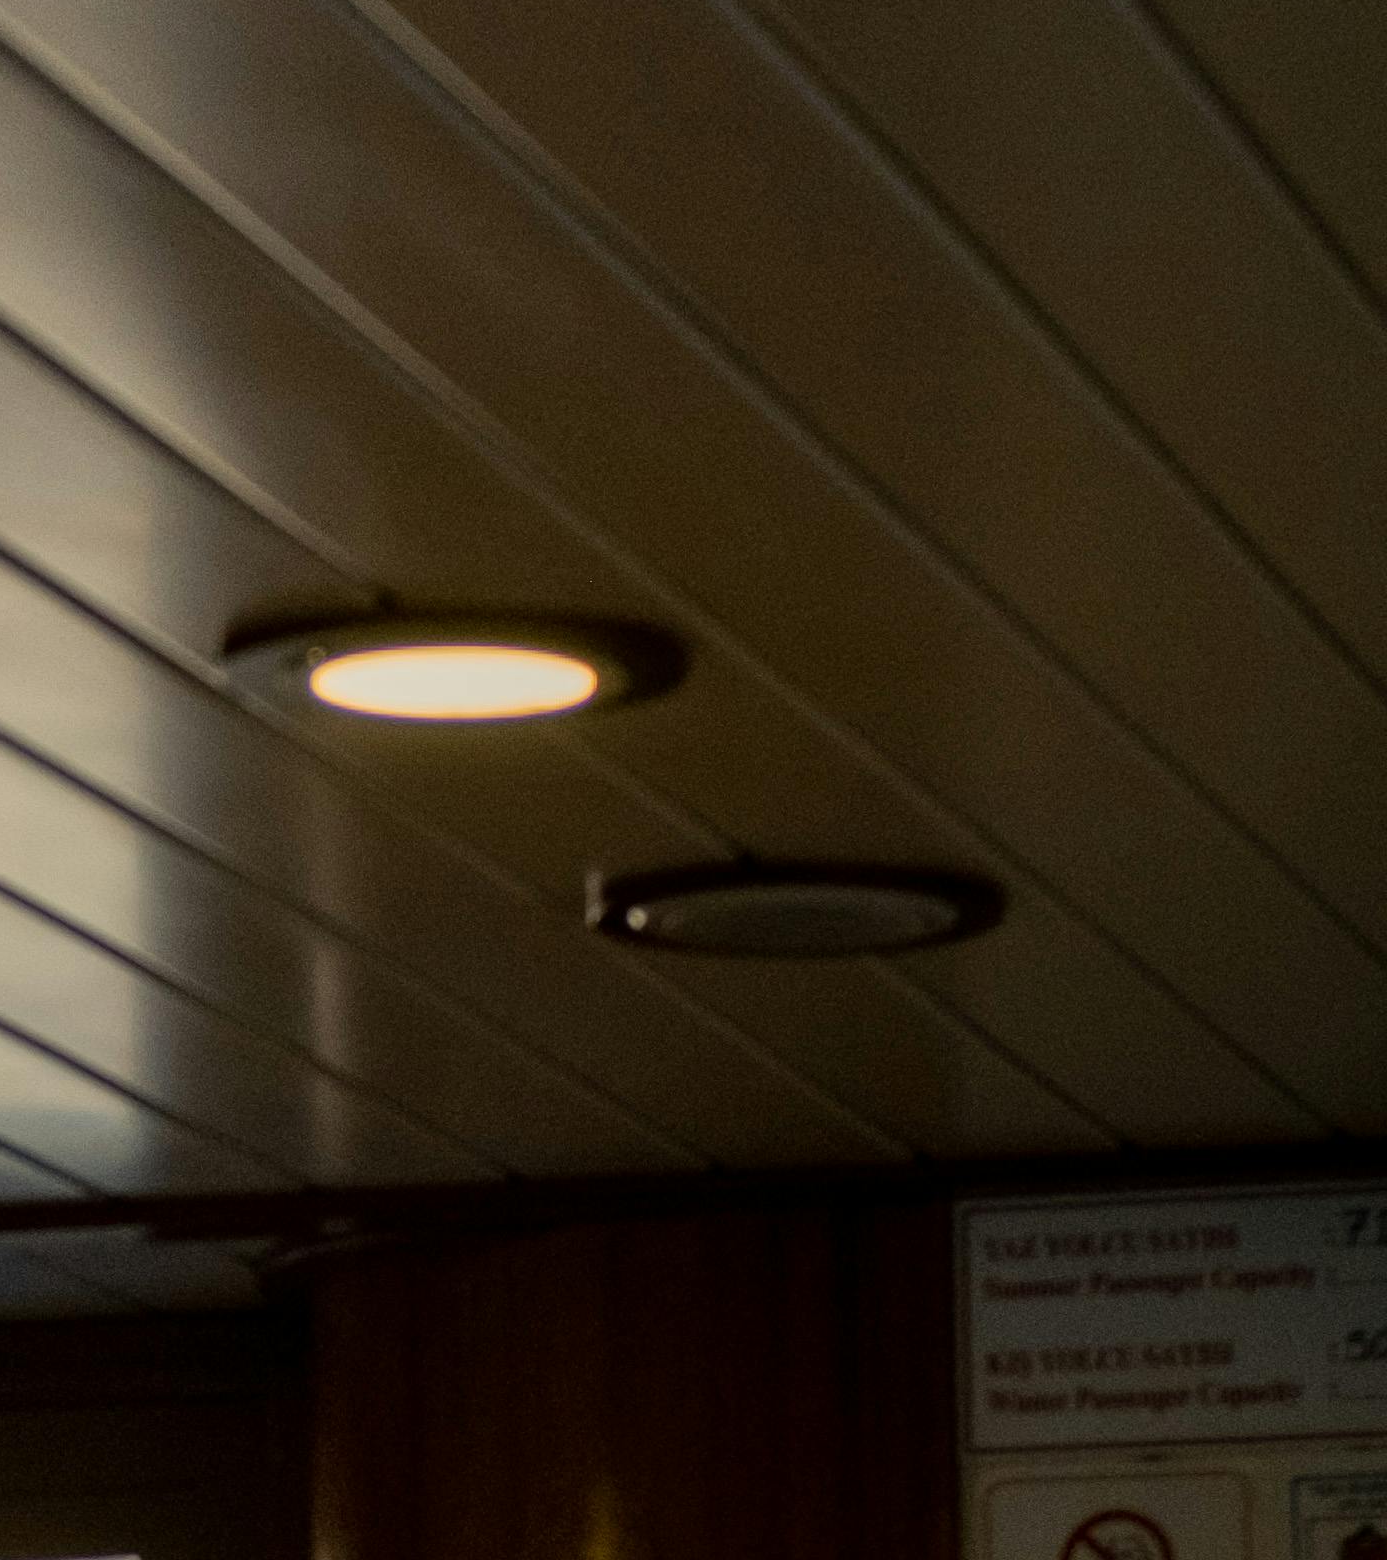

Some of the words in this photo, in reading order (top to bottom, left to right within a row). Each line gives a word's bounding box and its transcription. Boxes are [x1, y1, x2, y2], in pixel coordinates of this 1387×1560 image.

[984, 1276, 1081, 1298] Summer
[1090, 1270, 1202, 1297] Passenger
[1211, 1264, 1315, 1293] Capacity
[988, 1390, 1068, 1412] Winter
[1075, 1385, 1189, 1412] Passenger
[1195, 1381, 1300, 1408] Capacity
